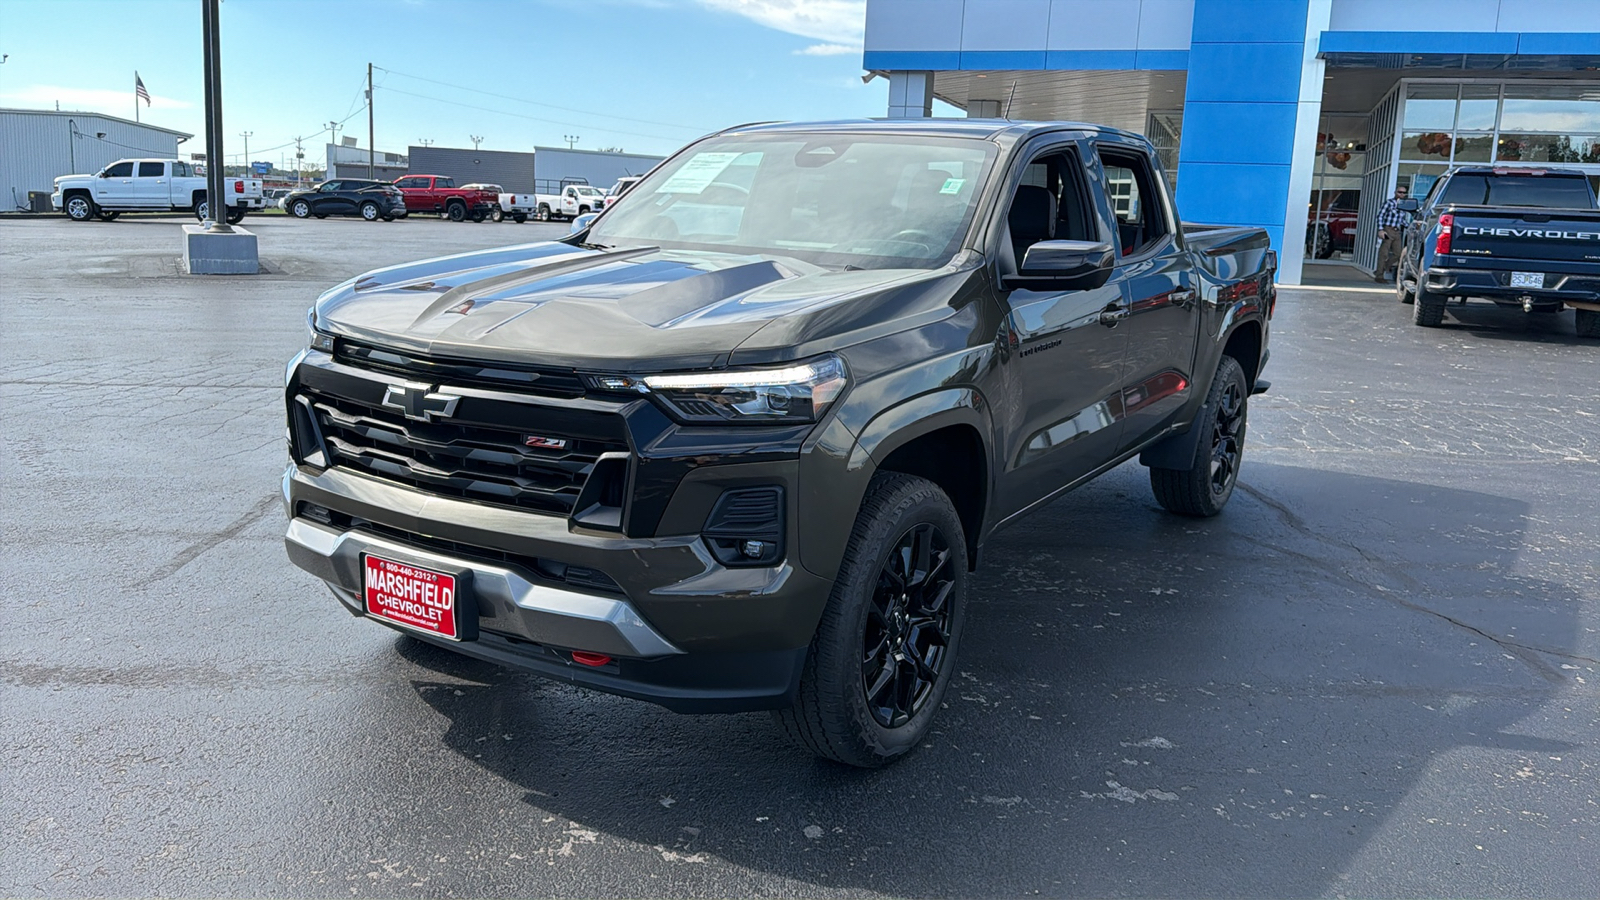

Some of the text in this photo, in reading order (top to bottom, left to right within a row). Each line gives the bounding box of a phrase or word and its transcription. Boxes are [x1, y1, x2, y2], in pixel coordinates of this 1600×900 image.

[1464, 227, 1600, 240] CHEVROLET
[526, 436, 566, 449] Z71
[386, 563, 432, 581] 800-440-2312
[367, 567, 452, 610] MARSHFIELD
[377, 593, 443, 621] CHEVROLET
